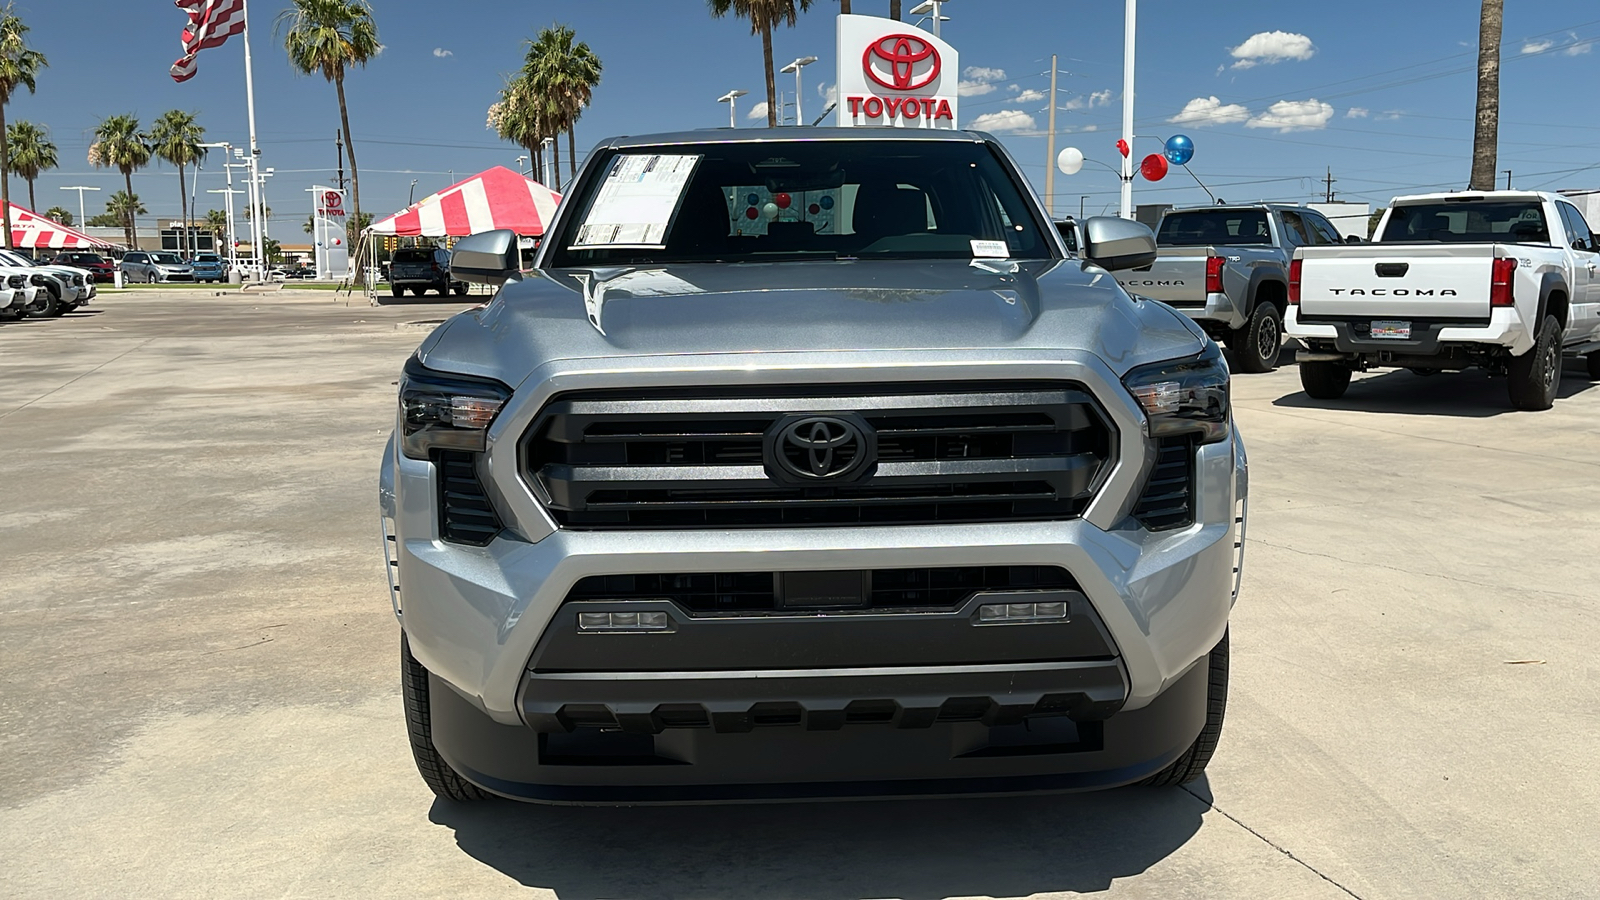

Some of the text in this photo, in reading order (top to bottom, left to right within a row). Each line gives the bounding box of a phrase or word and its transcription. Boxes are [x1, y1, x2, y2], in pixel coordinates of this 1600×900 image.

[847, 96, 953, 120] TOYOTA
[318, 208, 345, 216] TYOTA
[1329, 288, 1457, 296] TACOMA
